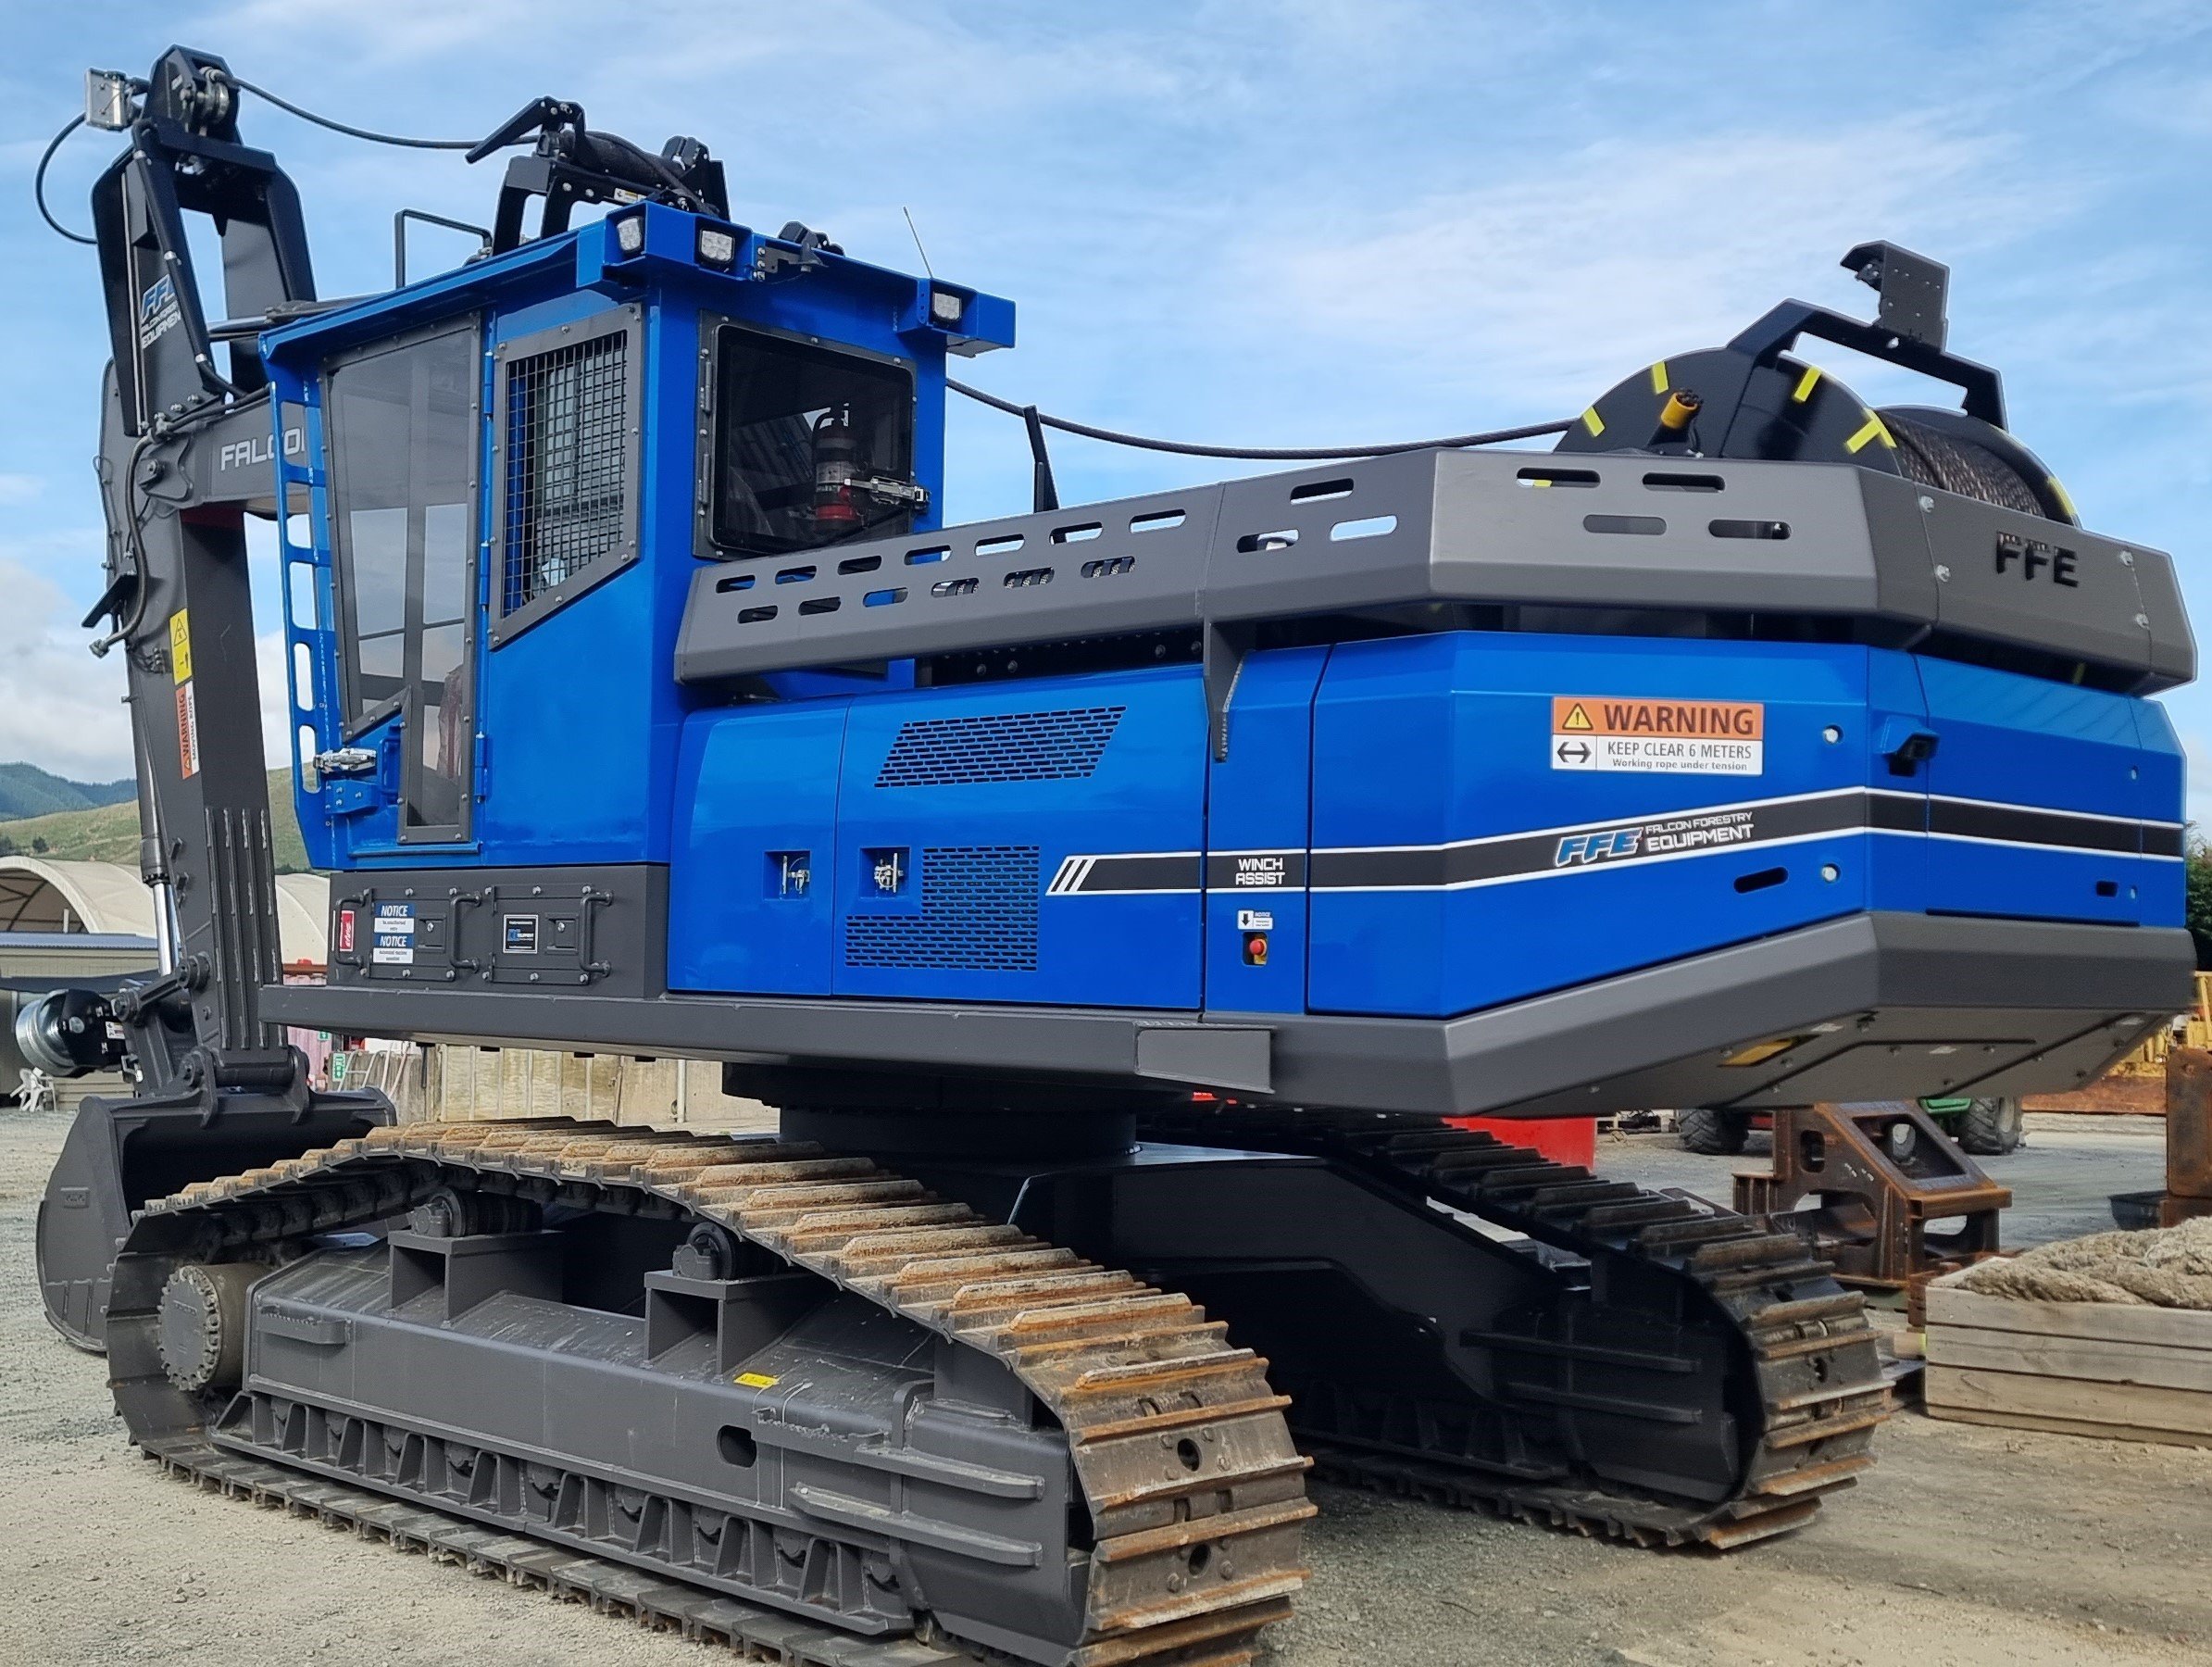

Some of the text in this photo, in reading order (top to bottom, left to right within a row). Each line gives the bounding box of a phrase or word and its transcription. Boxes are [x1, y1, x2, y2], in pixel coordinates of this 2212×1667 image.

[1996, 531, 2079, 588] FFE
[1604, 704, 1754, 734] WARNING
[1607, 741, 1752, 758] KEEP CLEAR 6 METERS
[1613, 758, 1747, 771] Working rope under tension
[1645, 811, 1753, 834] FALCON FORESTRY
[1647, 823, 1755, 852] EQUIPMENT
[1555, 827, 1643, 867] FFE
[1238, 857, 1283, 871] WINCH
[1235, 871, 1285, 885] ASSIST
[381, 905, 408, 917] NOTICE
[380, 935, 407, 947] NOTICE
